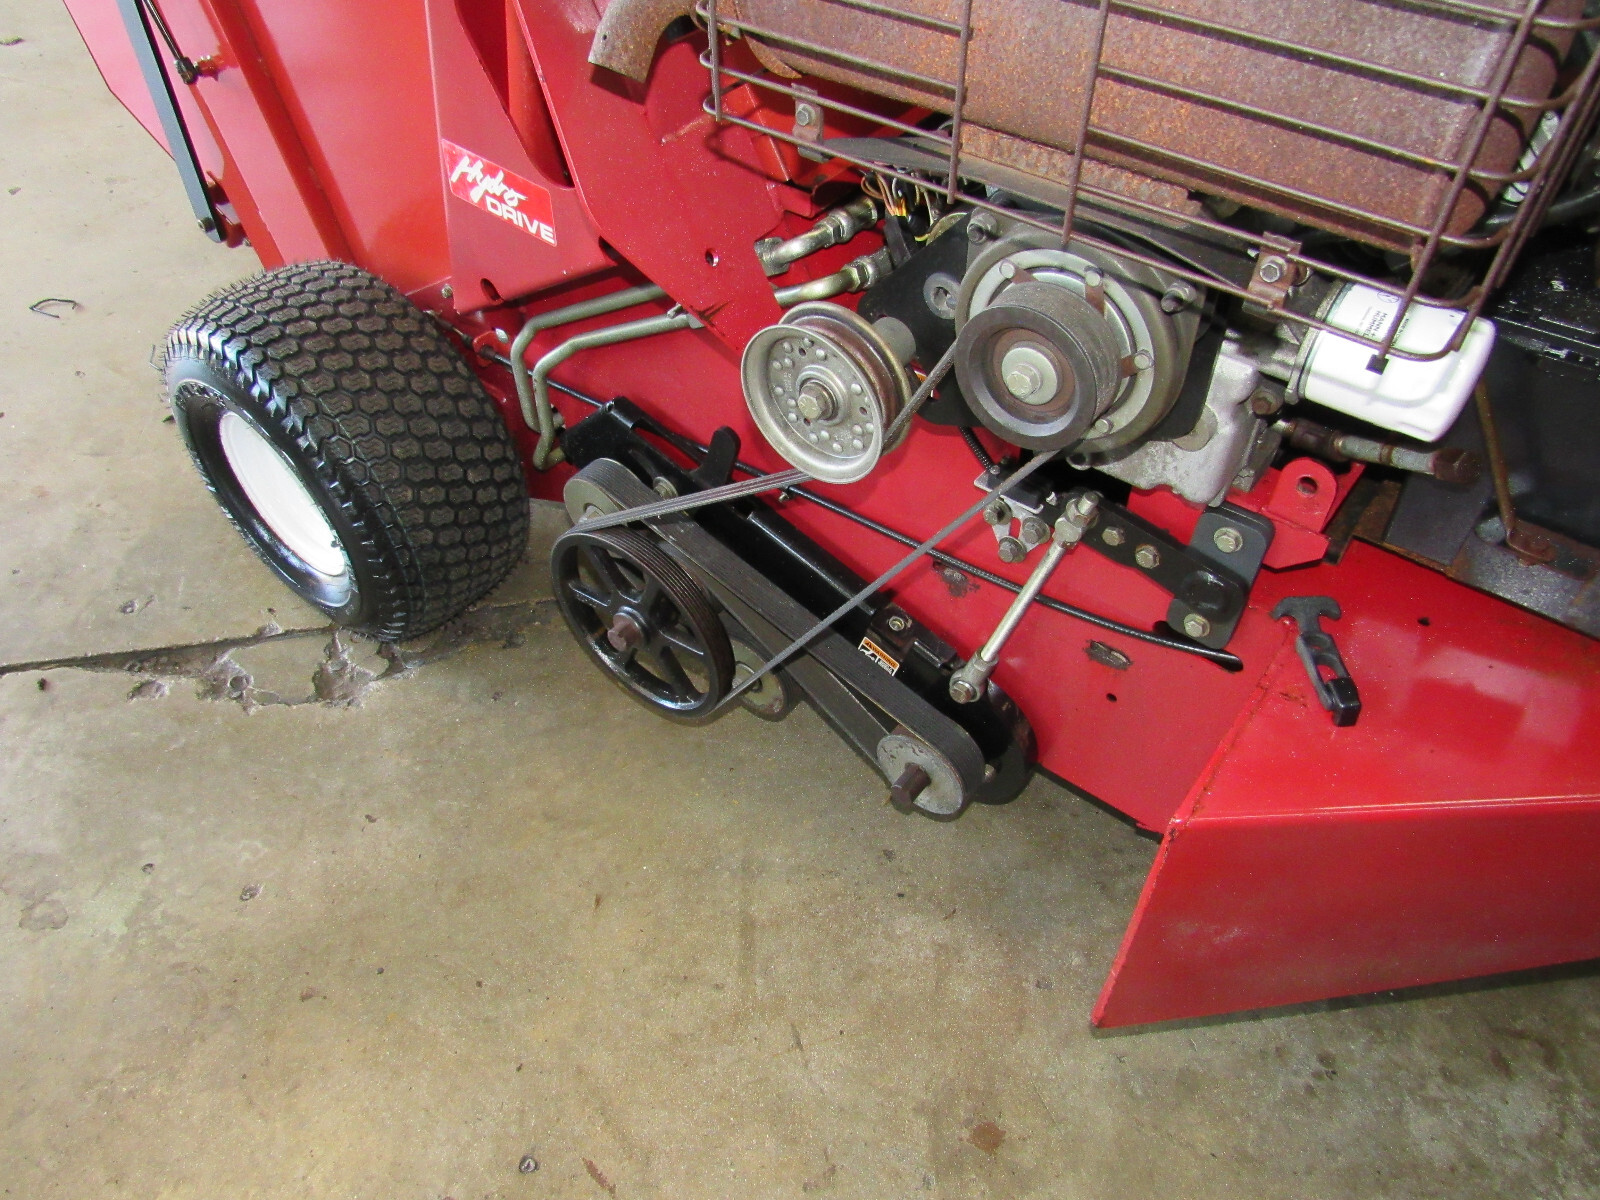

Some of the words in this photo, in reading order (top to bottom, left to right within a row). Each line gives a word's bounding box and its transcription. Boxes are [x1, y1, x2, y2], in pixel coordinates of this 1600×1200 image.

[450, 155, 528, 207] Hydro
[485, 195, 555, 244] DRIVE
[1373, 312, 1388, 331] MANN
